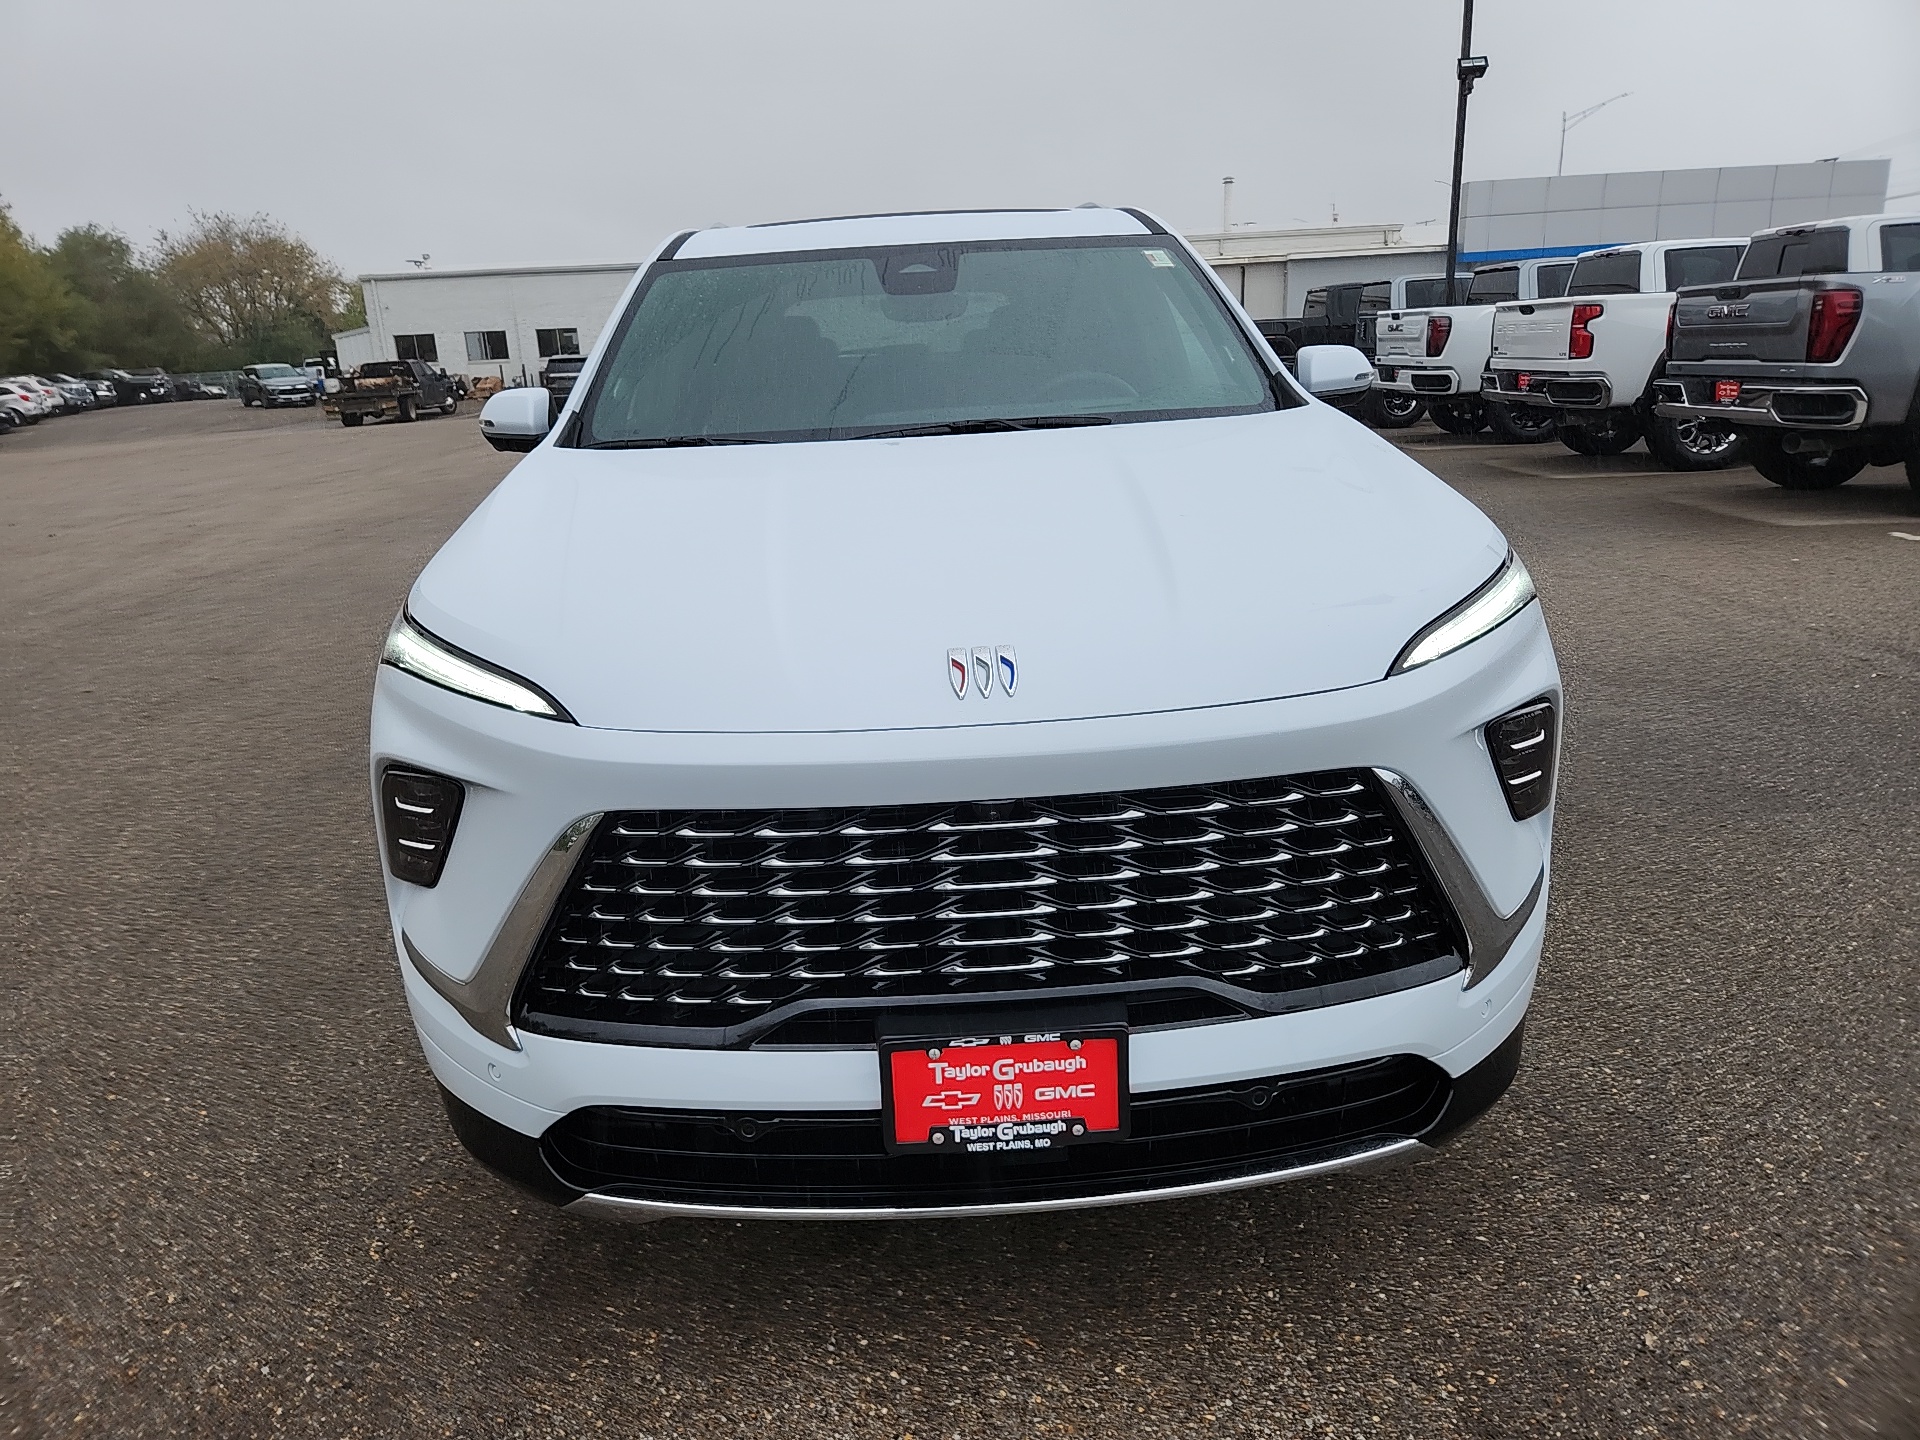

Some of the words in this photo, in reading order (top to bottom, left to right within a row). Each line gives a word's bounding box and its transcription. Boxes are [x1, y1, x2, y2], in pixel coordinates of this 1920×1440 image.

[1707, 303, 1750, 318] GMC
[1024, 1032, 1061, 1043] GMC
[927, 1062, 990, 1084] Taylor
[992, 1055, 1087, 1081] Grubaugh
[1034, 1083, 1096, 1100] GMC
[947, 1116, 979, 1126] WEST
[980, 1114, 1021, 1124] PLAINS,
[1022, 1109, 1072, 1121] MISSOURI
[948, 1125, 996, 1143] Taylor
[996, 1119, 1067, 1141] Grubaugh
[966, 1142, 995, 1153] WEST
[996, 1140, 1034, 1151] PLAINS,
[1034, 1138, 1052, 1147] MO
